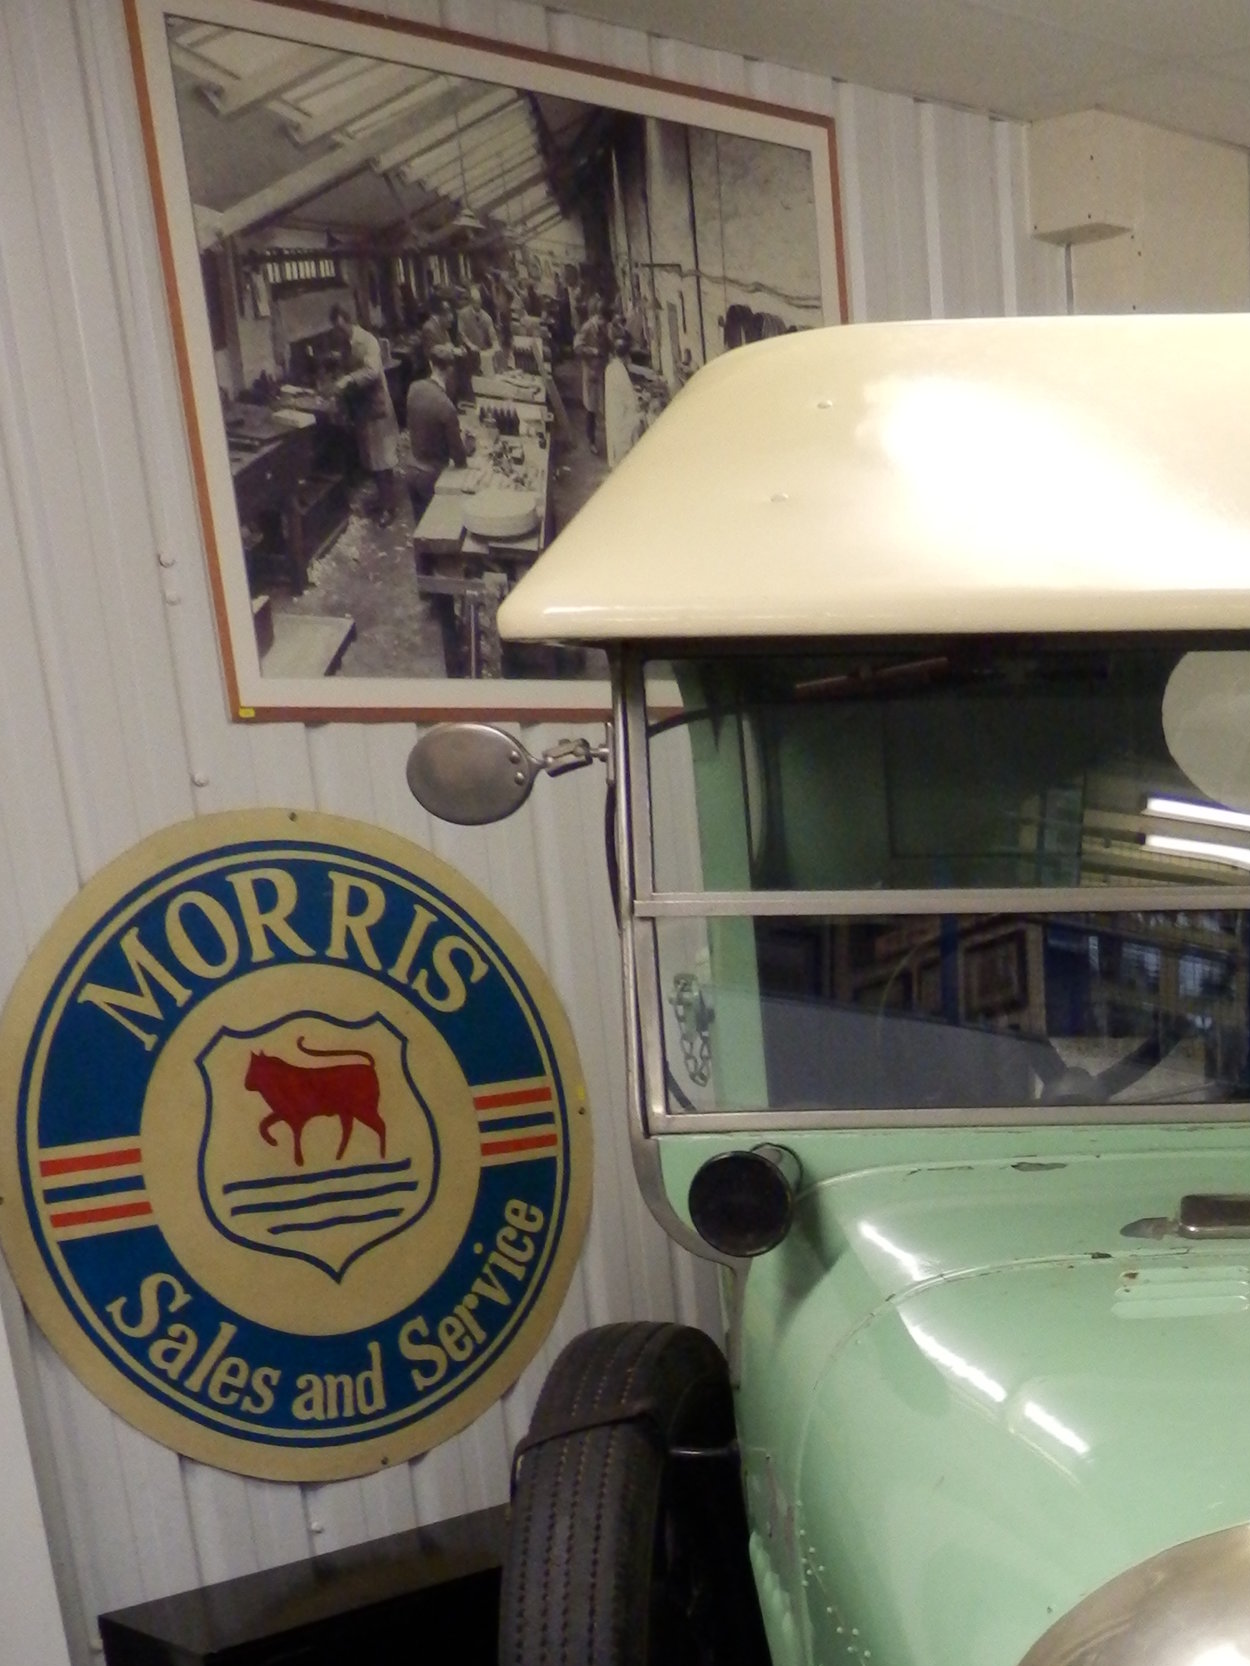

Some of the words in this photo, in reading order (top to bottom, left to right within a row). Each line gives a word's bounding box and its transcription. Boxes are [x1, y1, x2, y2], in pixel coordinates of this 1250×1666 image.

[77, 868, 490, 1050] MORRIS
[106, 1273, 281, 1415] Sales
[291, 1344, 387, 1421] and
[398, 1197, 545, 1390] Service
